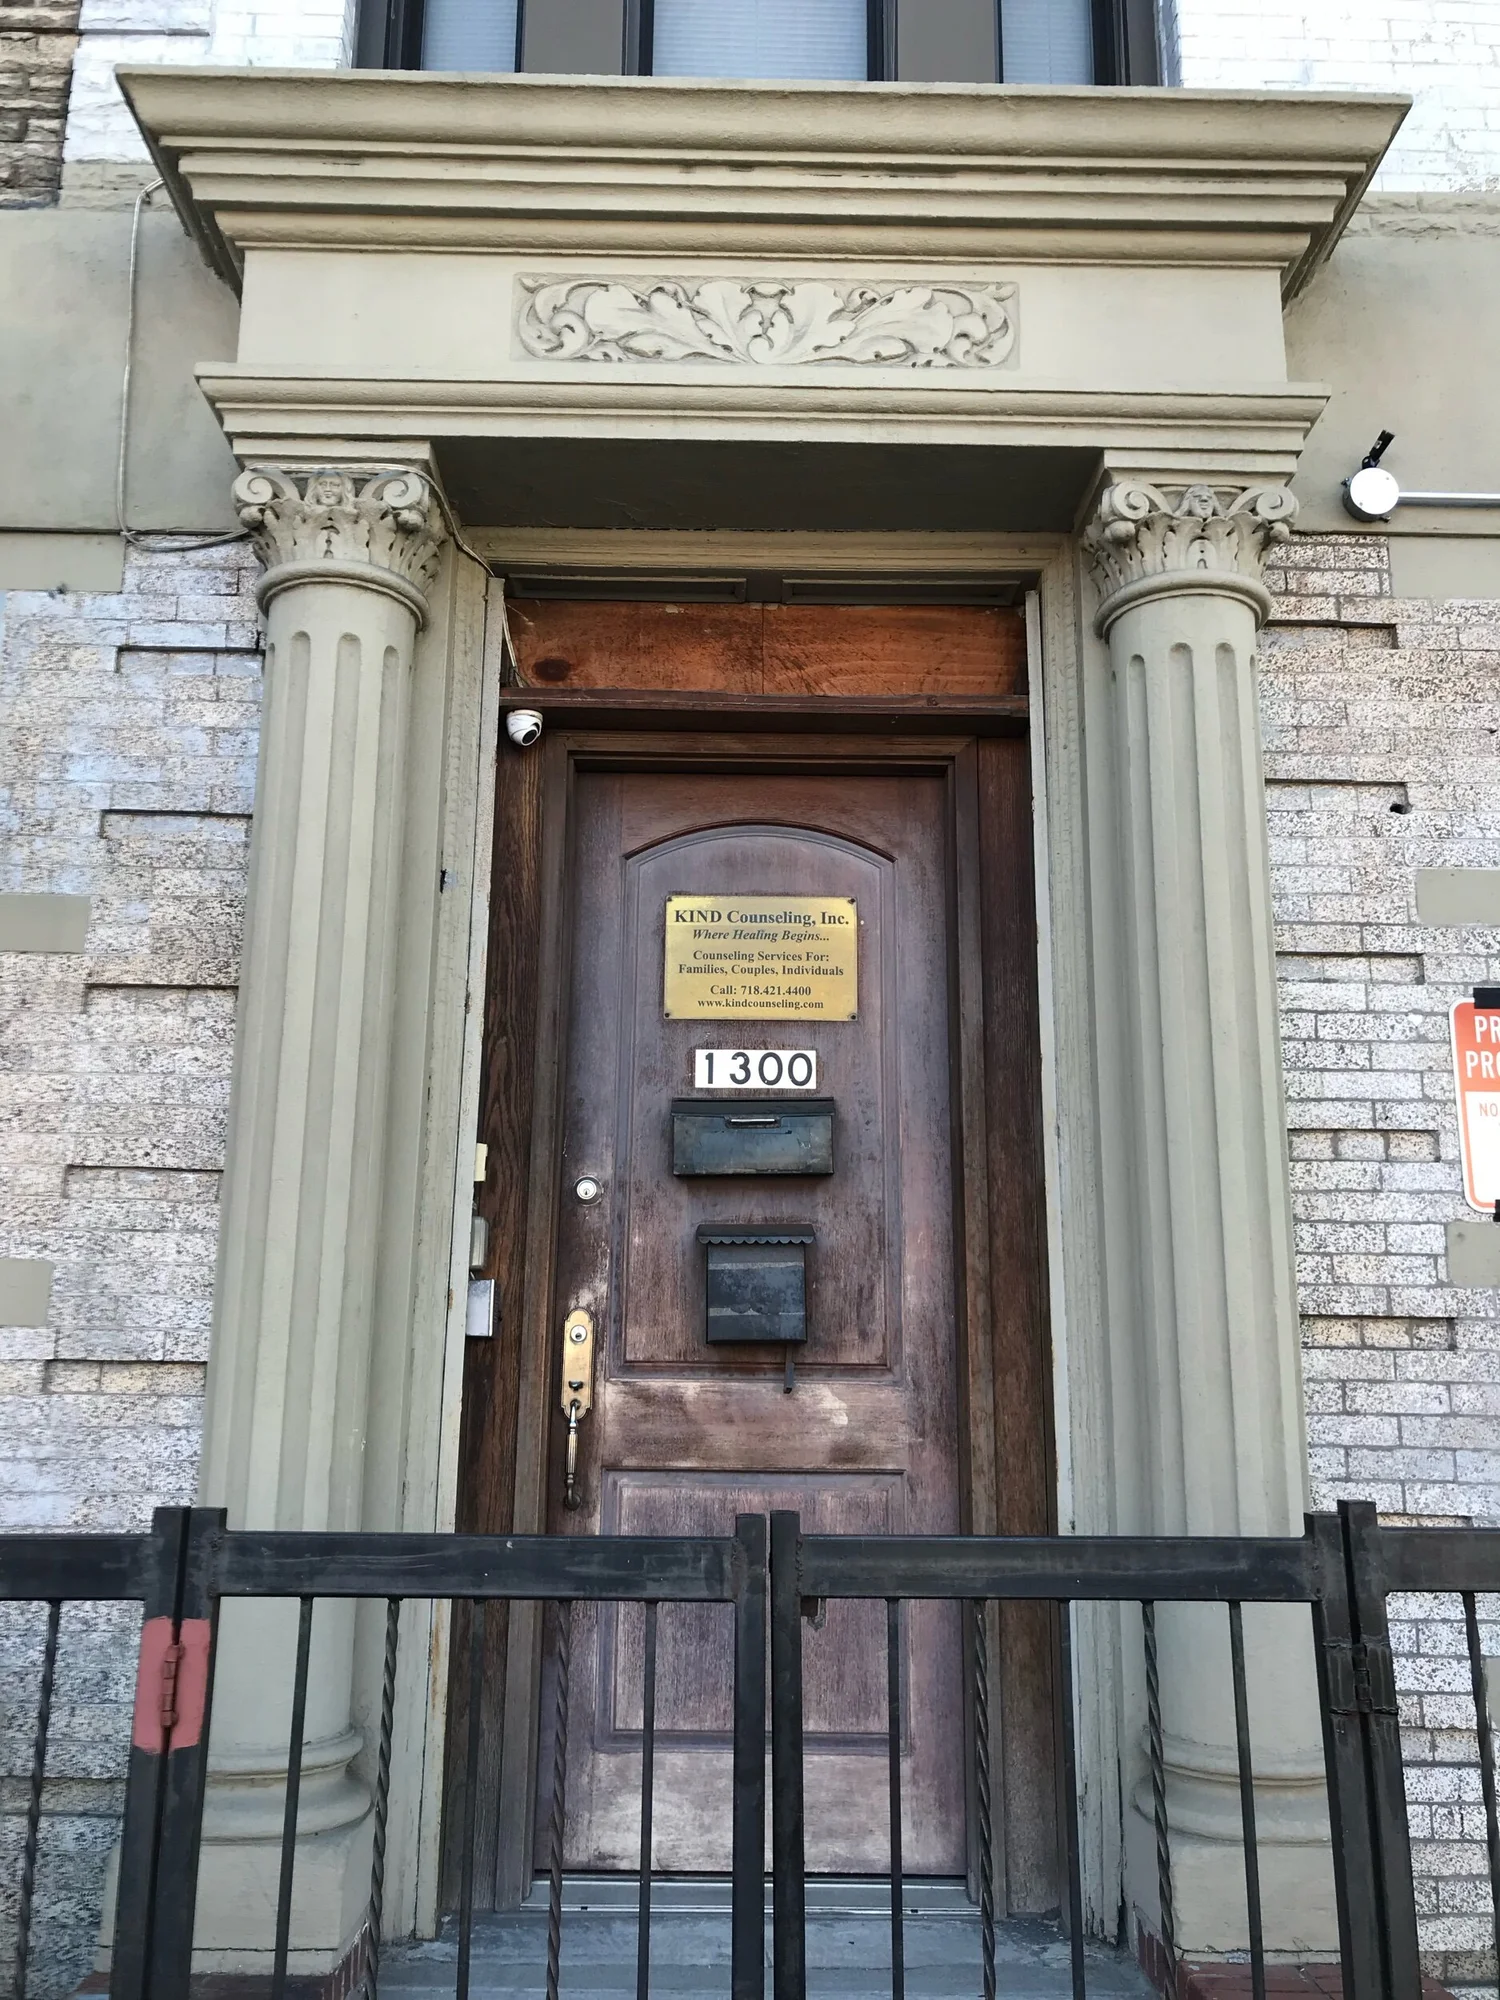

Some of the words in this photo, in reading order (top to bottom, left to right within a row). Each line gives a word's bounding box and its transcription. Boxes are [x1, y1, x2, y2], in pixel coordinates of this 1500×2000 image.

[675, 910, 721, 923] KIND
[727, 910, 816, 926] Counseling,
[821, 911, 849, 924] Inc.
[693, 930, 729, 939] Where
[732, 930, 777, 942] Healing
[782, 931, 829, 942] Begins...
[693, 951, 754, 962] Counseling
[758, 951, 802, 961] Services
[806, 952, 829, 961] For:
[679, 964, 727, 975] Families,
[731, 965, 779, 976] Couples,
[782, 966, 844, 976] Individuals
[711, 985, 736, 994] Call:
[741, 985, 811, 996] 718.421.4400
[698, 999, 824, 1010] www.kindcounseling.com
[705, 1052, 812, 1086] 1300
